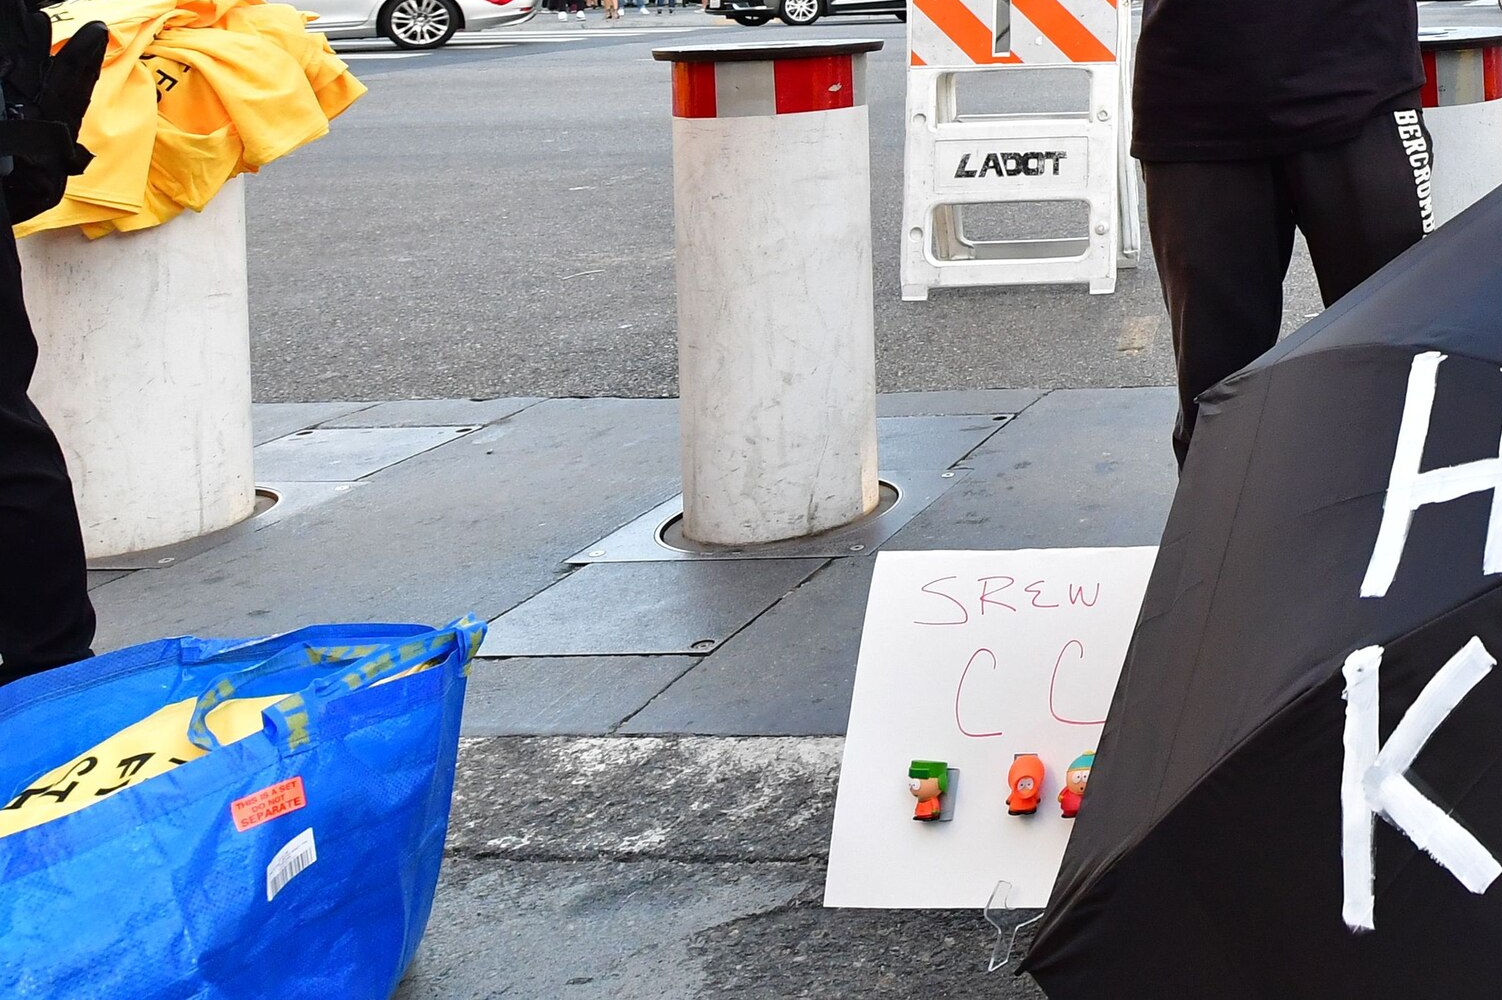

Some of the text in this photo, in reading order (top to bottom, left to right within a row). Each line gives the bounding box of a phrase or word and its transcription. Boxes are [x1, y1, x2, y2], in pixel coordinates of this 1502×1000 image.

[954, 151, 1067, 178] LADOT
[1393, 109, 1436, 239] BERCROMB
[913, 575, 1101, 625] SREW
[235, 780, 297, 810] THIS IS A SET
[251, 794, 286, 813] DO NOT
[240, 796, 302, 828] SEPARATE
